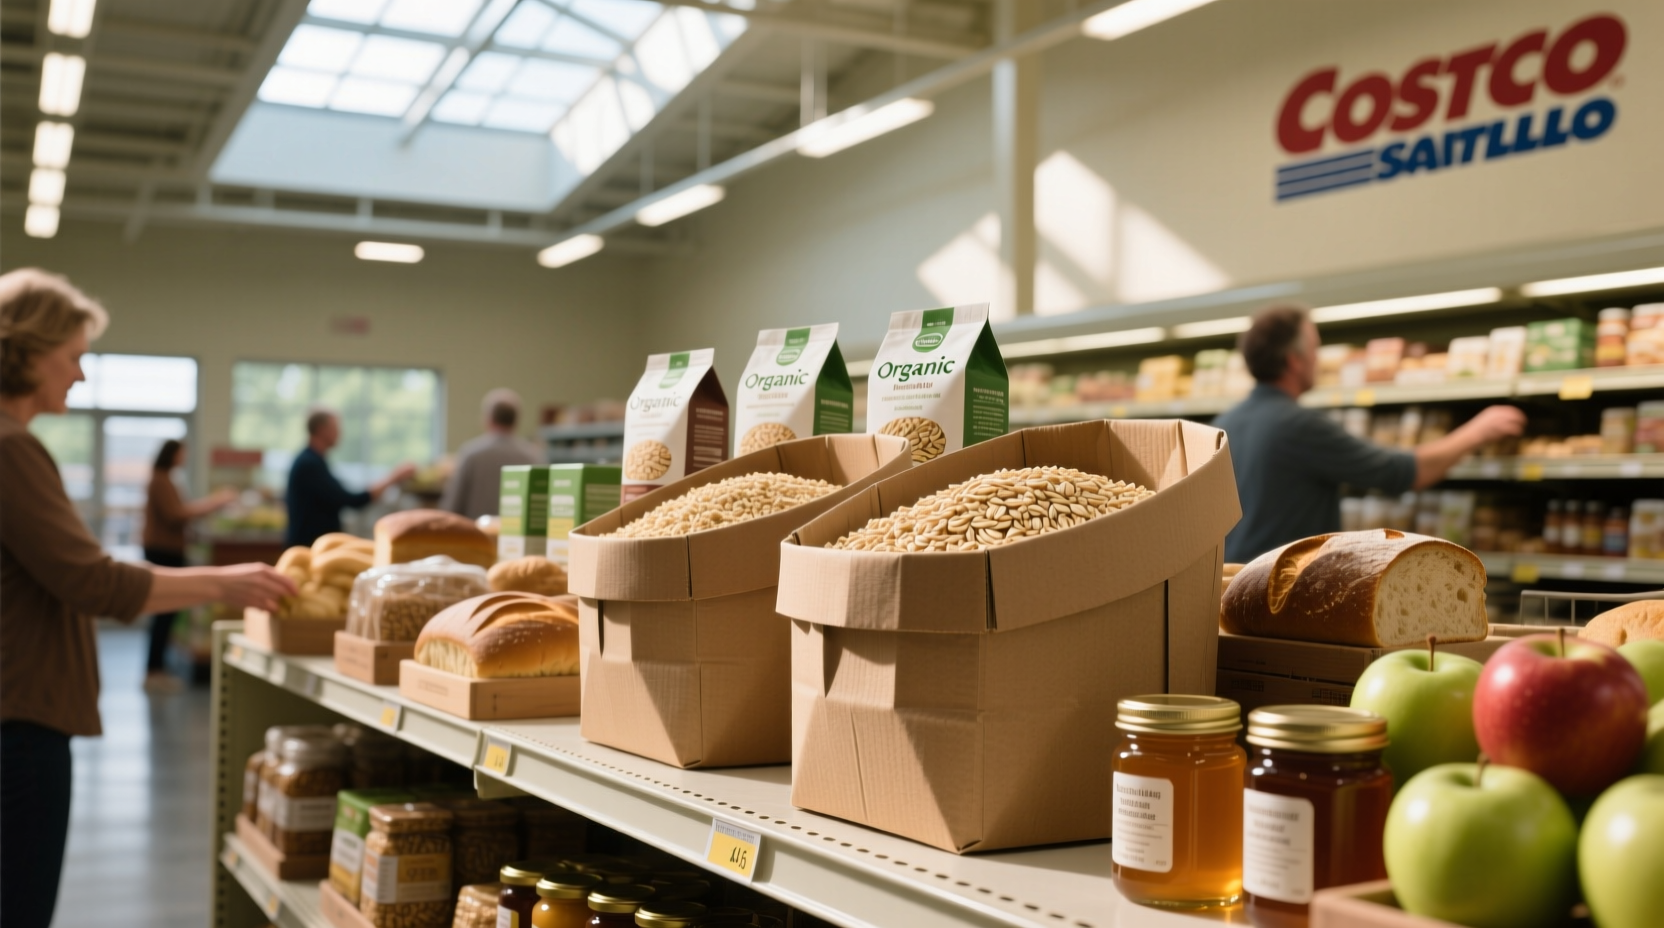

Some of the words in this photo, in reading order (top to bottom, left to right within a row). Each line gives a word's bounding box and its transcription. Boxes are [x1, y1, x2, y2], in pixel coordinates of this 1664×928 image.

[1275, 11, 1628, 155] COSTCO
[745, 368, 810, 392] Organic
[877, 356, 956, 383] Organic
[630, 391, 683, 413] Organic
